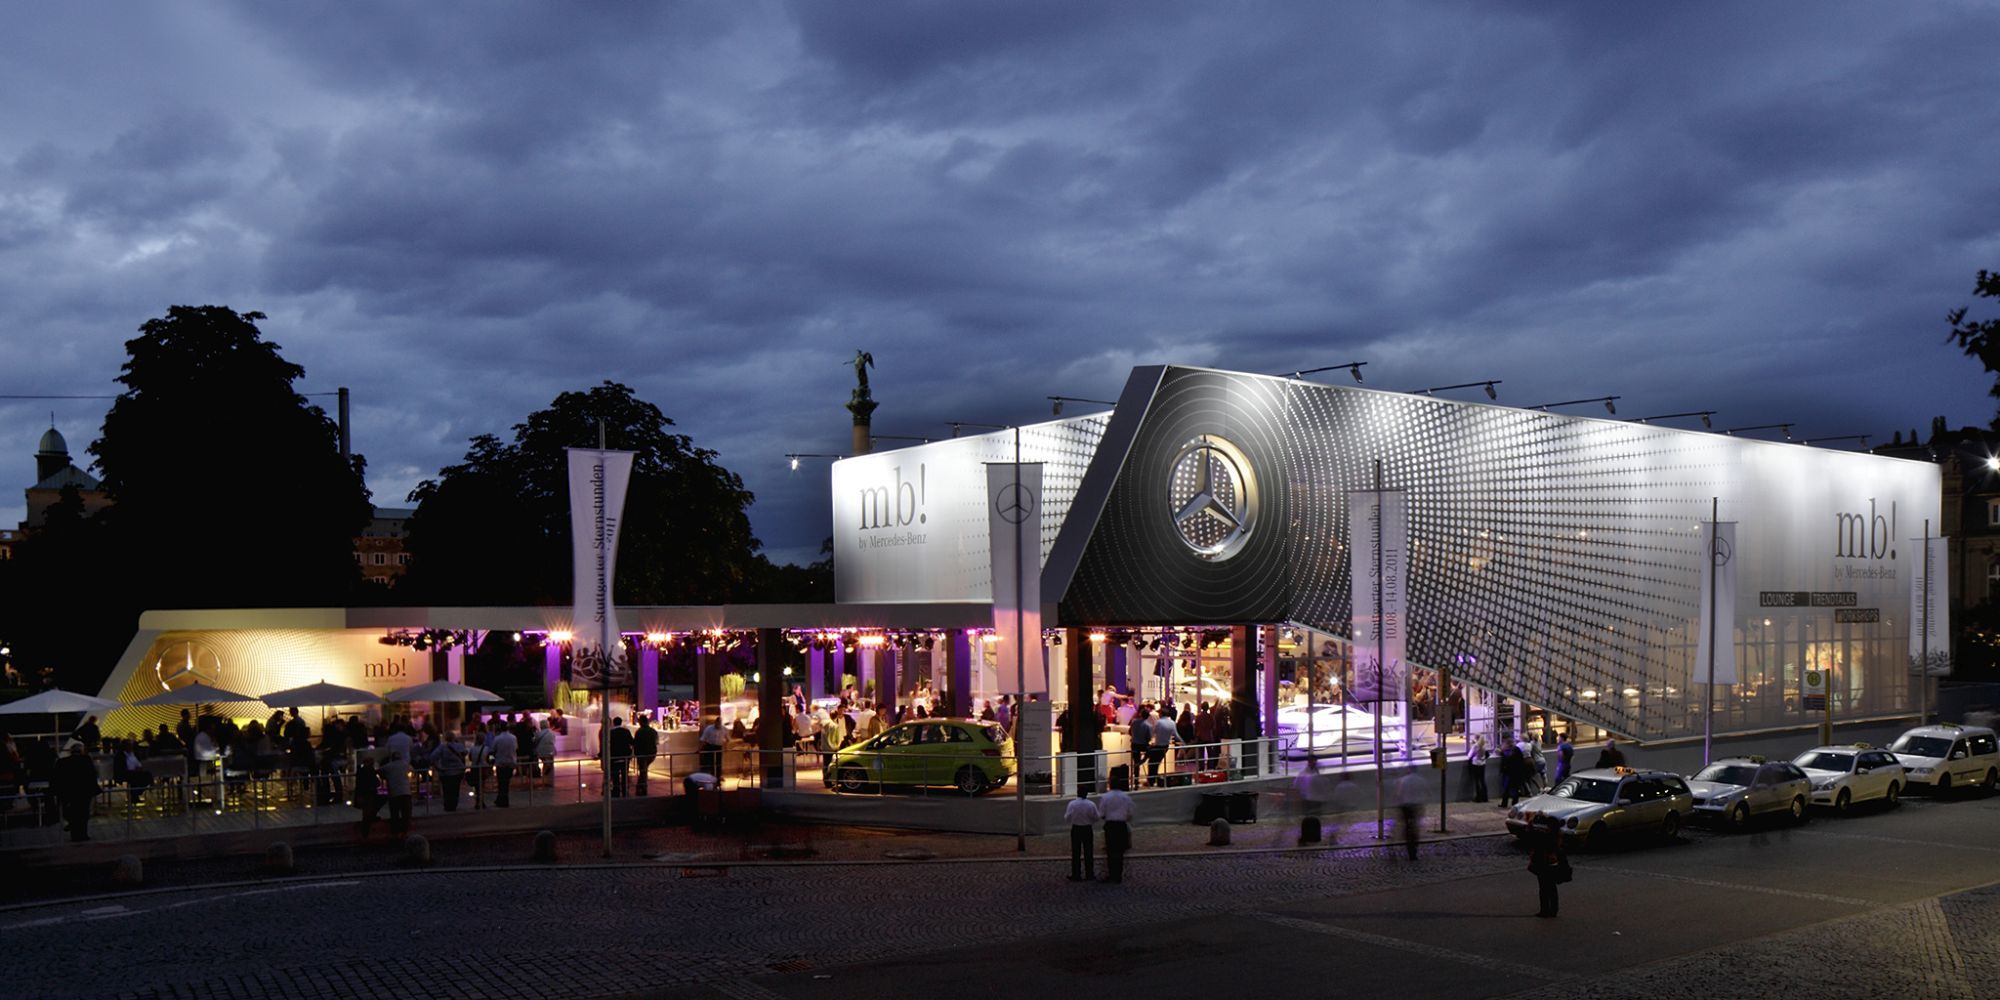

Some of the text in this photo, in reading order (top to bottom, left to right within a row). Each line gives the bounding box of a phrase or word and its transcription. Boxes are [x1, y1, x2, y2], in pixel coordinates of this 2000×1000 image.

[590, 464, 604, 549] Sternstunden
[858, 463, 927, 531] mb!
[1835, 497, 1897, 560] mb!
[869, 531, 927, 549] Mercedes-Benz
[1761, 593, 1795, 606] LOUNGE
[1812, 593, 1856, 605] TRENDTALKS
[364, 658, 407, 678] mb!
